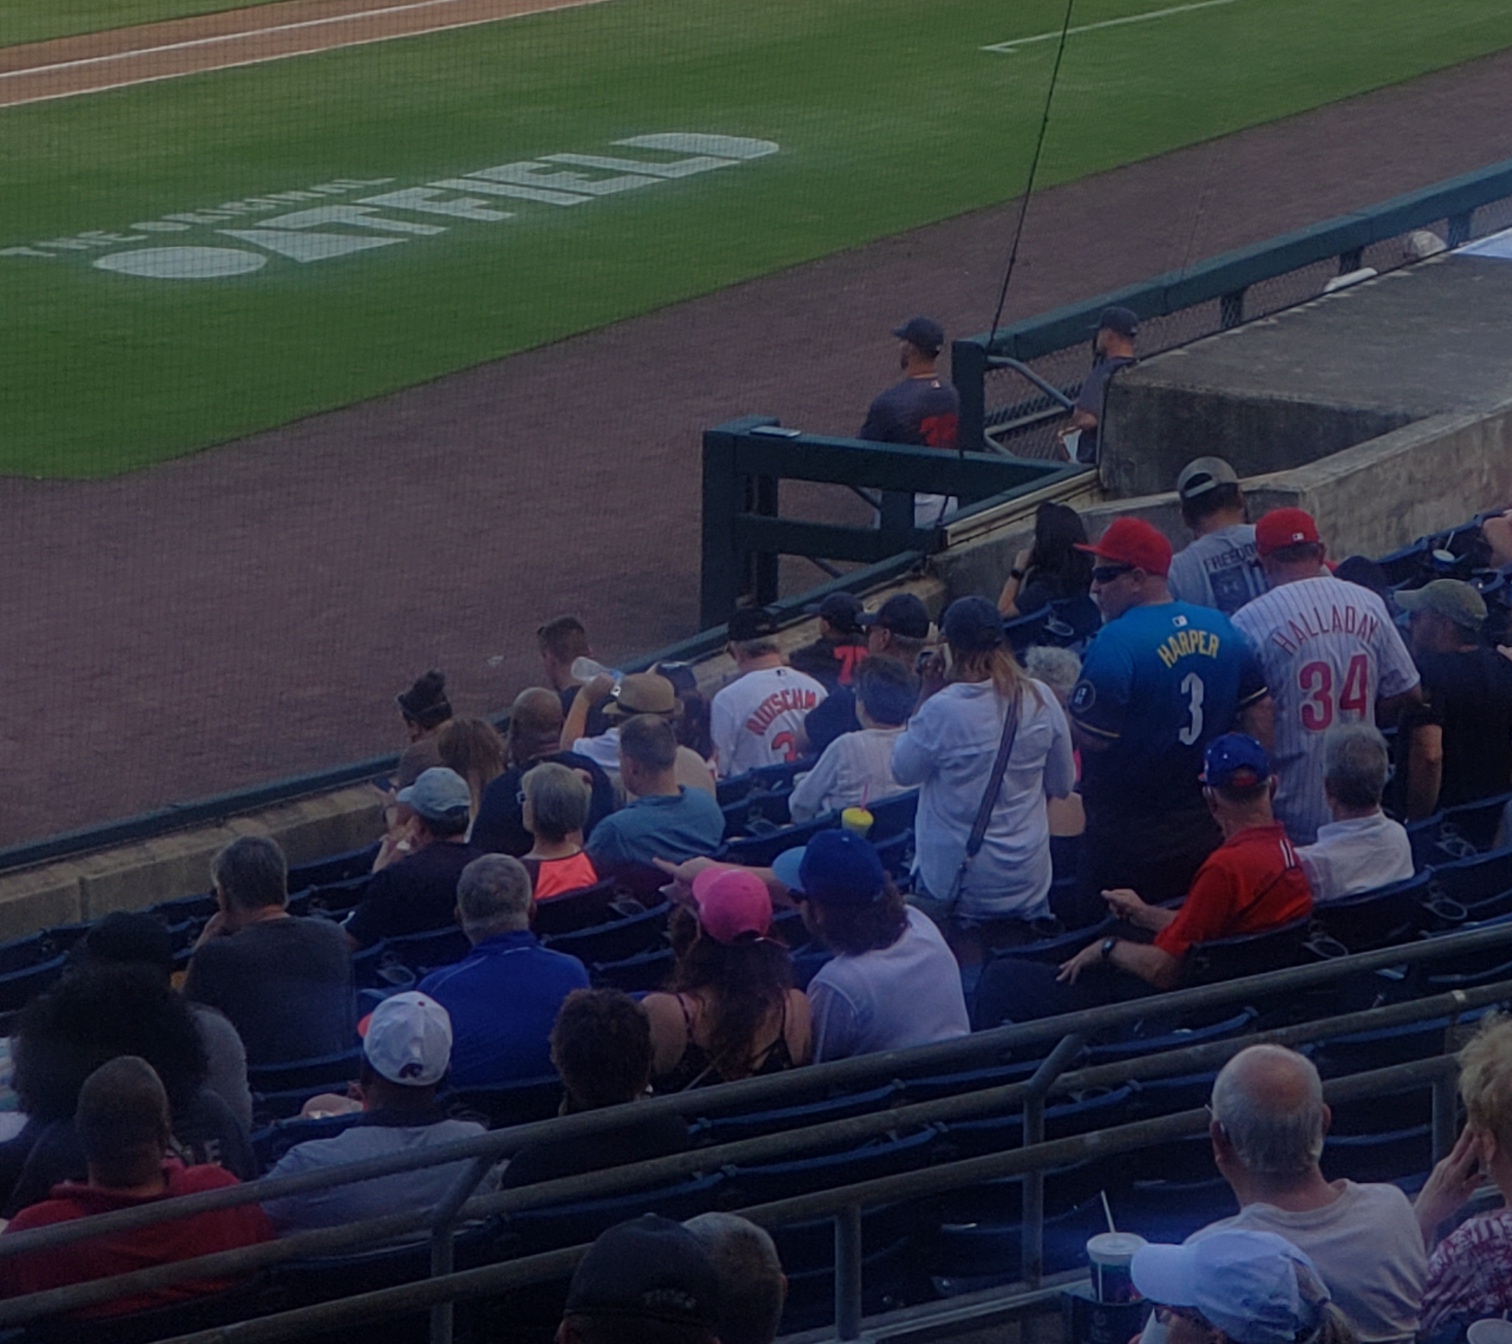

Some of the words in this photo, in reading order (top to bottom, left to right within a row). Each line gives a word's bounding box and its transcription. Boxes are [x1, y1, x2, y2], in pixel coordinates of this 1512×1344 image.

[92, 132, 780, 280] OATFIELD
[1, 229, 147, 259] THE
[1203, 541, 1257, 572] FREEDO
[1157, 630, 1220, 668] HARPER
[1272, 605, 1381, 656] HALLADAY
[1179, 672, 1204, 746] 3
[1299, 654, 1370, 732] 34
